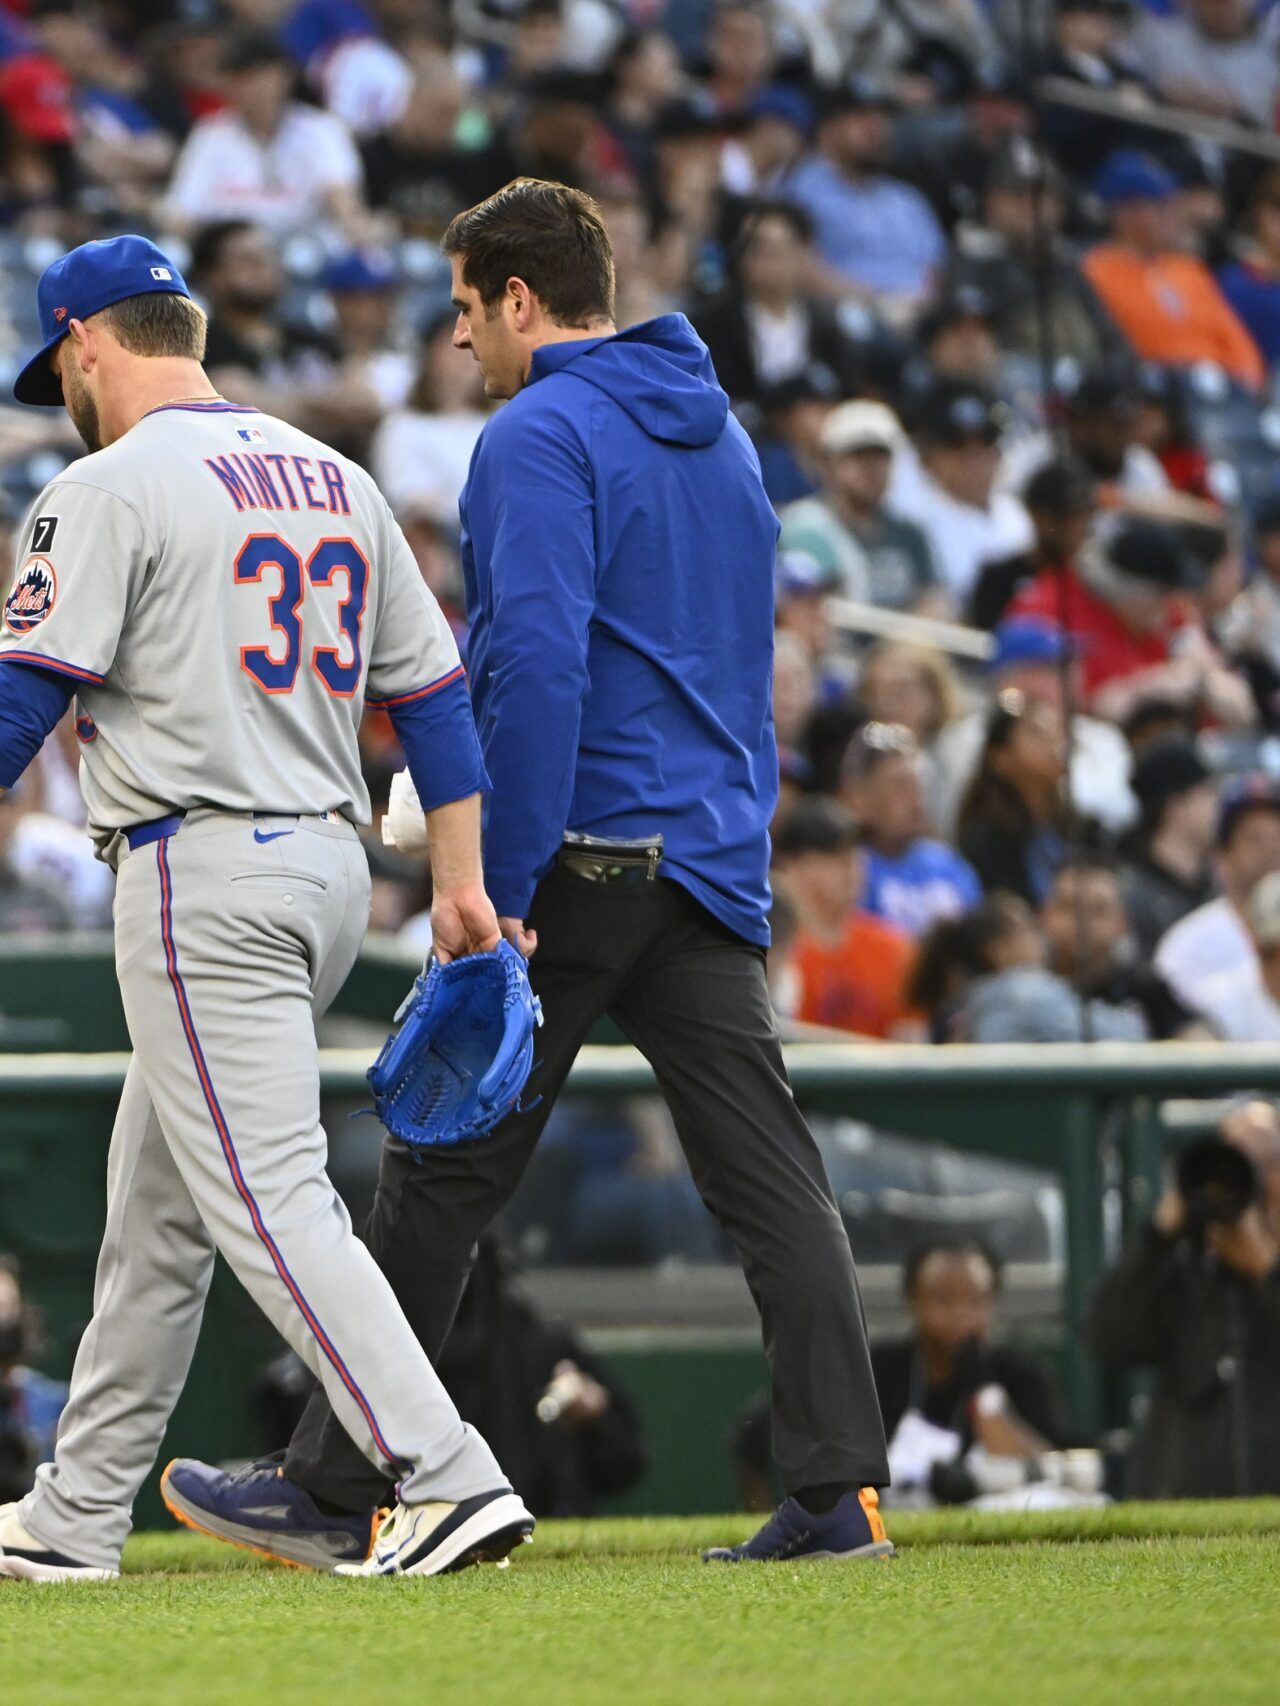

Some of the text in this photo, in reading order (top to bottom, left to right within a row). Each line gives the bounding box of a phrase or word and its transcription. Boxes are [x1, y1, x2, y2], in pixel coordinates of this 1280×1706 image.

[204, 453, 352, 516] MINTER
[35, 521, 50, 549] 7
[10, 585, 48, 611] Mets
[233, 533, 369, 698] 33
